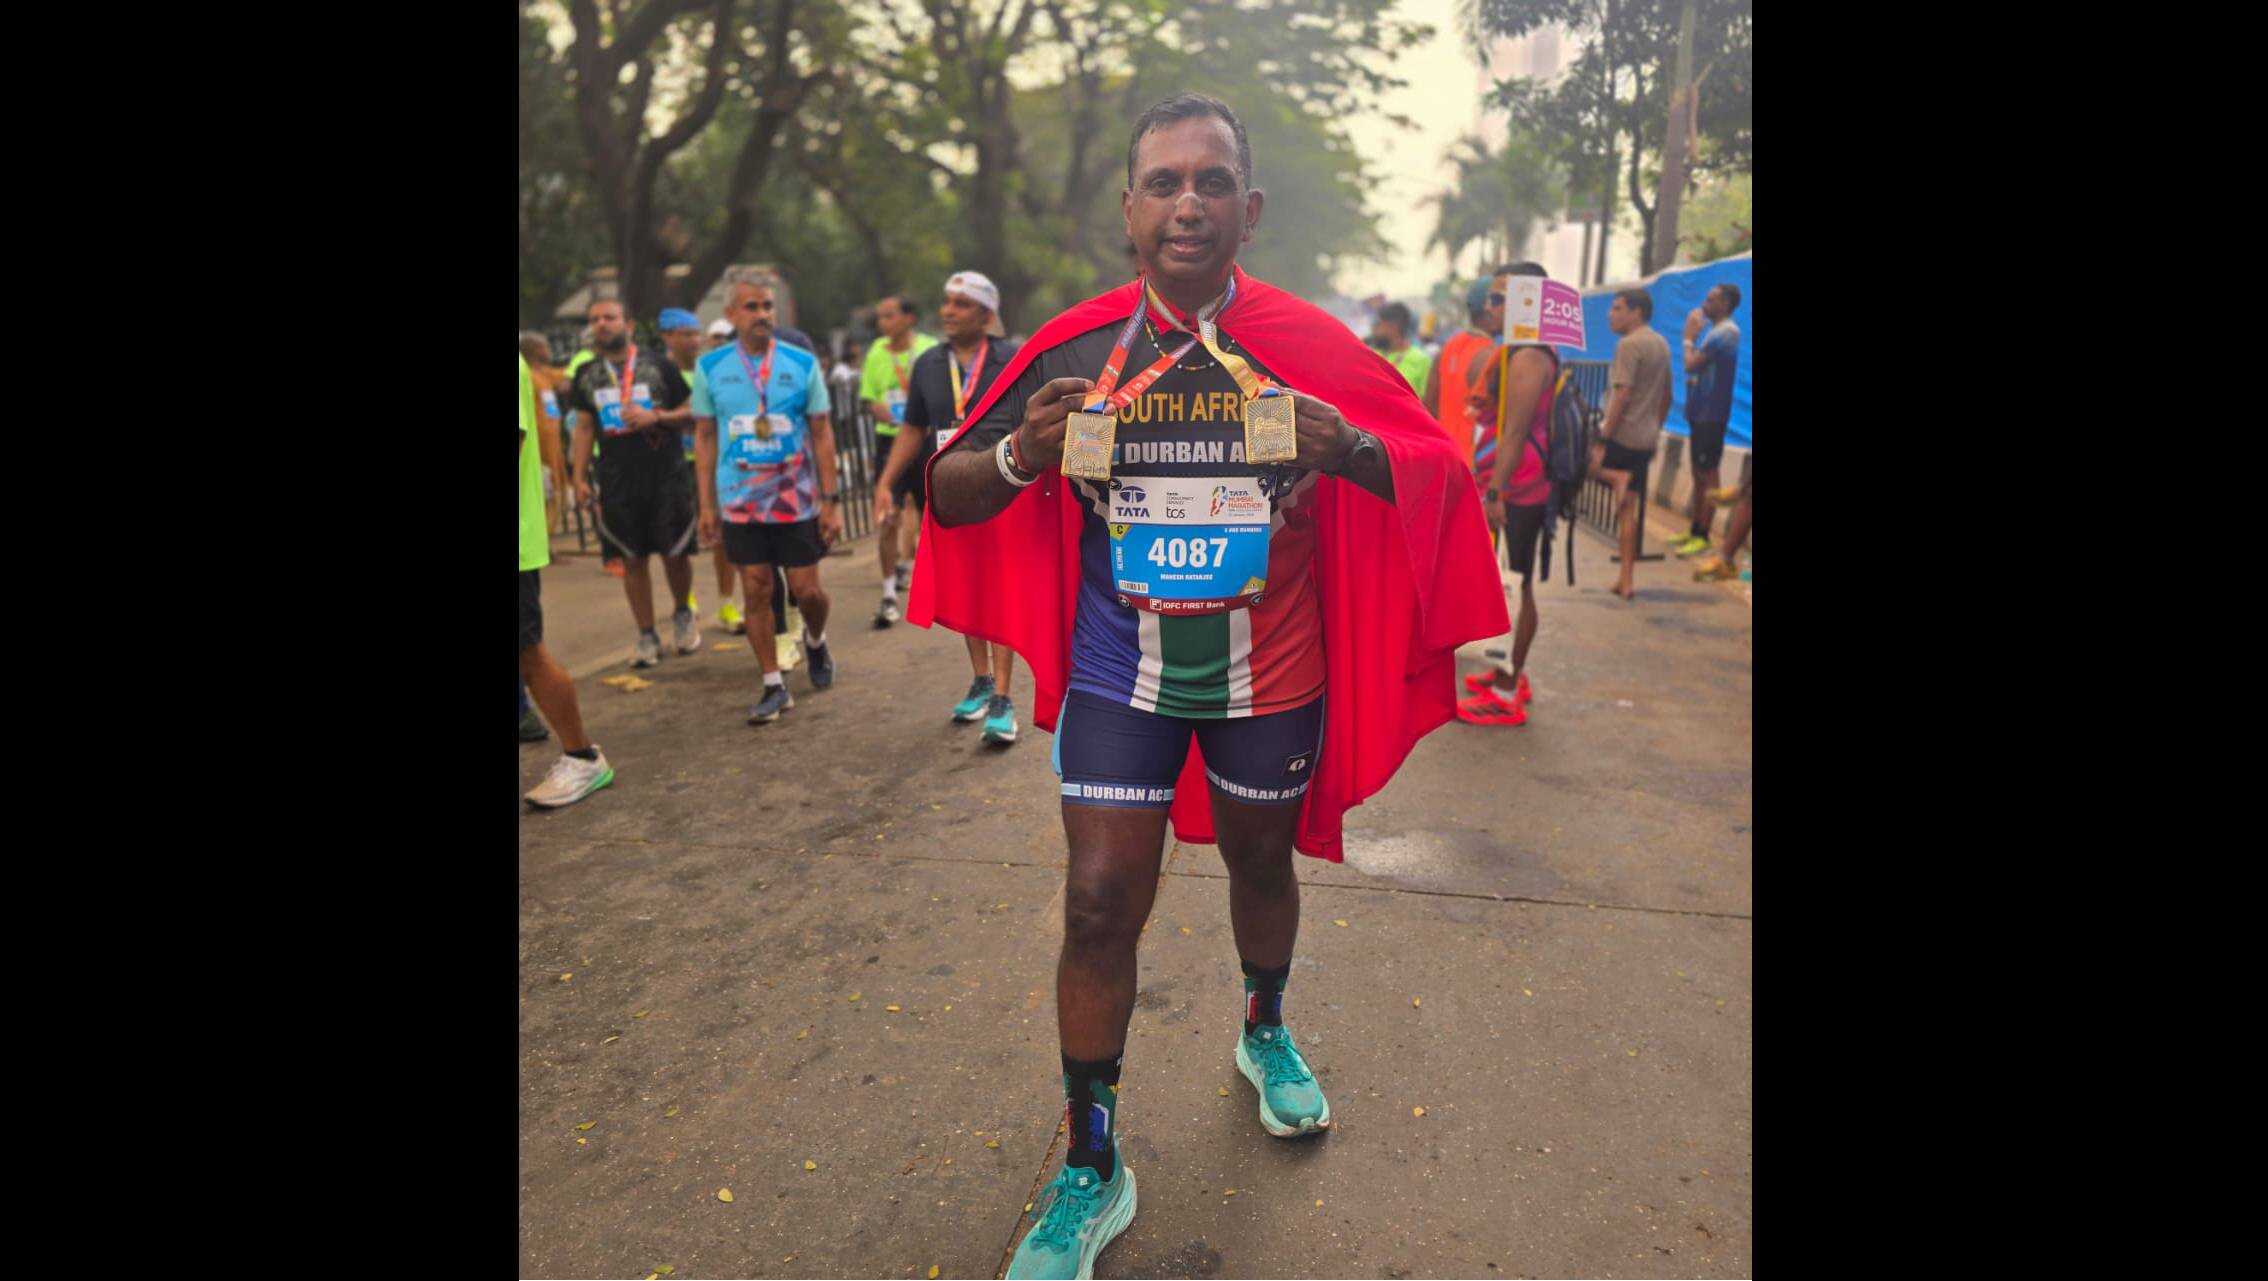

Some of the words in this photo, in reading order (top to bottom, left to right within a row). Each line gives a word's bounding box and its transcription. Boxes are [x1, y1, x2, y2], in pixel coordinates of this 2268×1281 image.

[1118, 393, 1184, 424] OUTH
[1190, 392, 1246, 422] AFRI
[1125, 441, 1224, 463] DURBAN
[1229, 441, 1246, 463] A
[1115, 507, 1150, 518] TATA
[1166, 507, 1186, 519] tcs
[1148, 537, 1228, 568] 4087
[1206, 601, 1226, 609] Bank
[1083, 784, 1146, 801] DURBAN
[1148, 789, 1164, 801] AC
[1221, 779, 1279, 800] DURBAN
